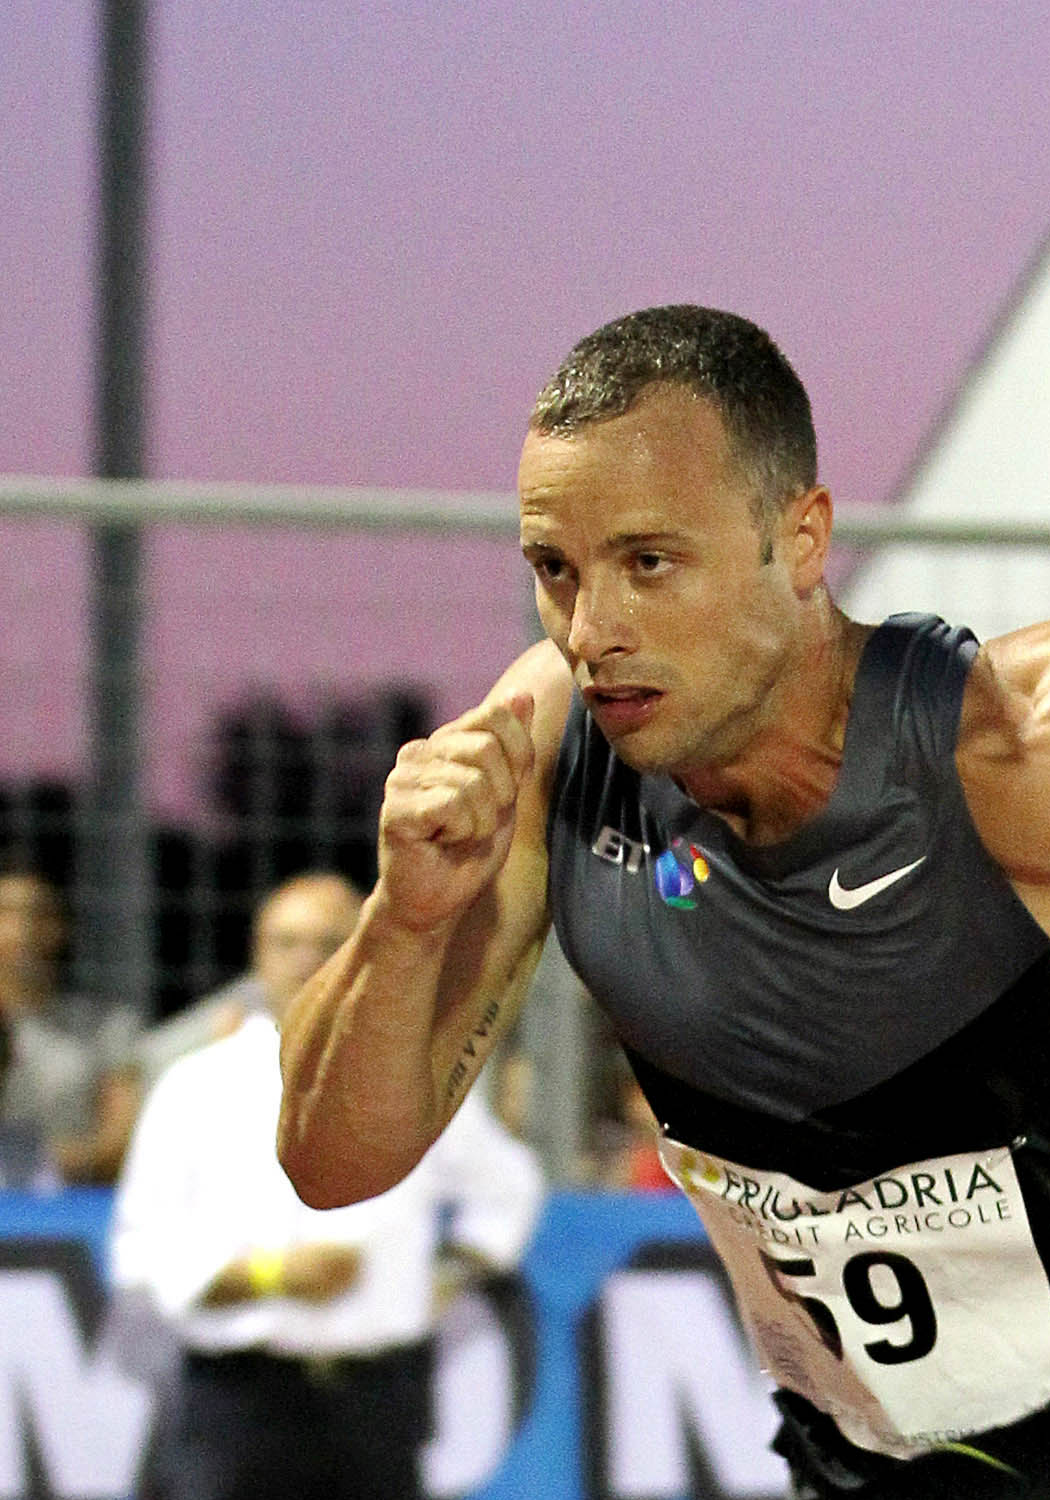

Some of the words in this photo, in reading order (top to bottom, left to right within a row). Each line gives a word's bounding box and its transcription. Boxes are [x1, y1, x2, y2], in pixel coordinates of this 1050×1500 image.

[722, 1162, 1003, 1221] FRIULADRIA
[844, 1199, 1012, 1243] AGRICOLE
[759, 1248, 938, 1365] 59
